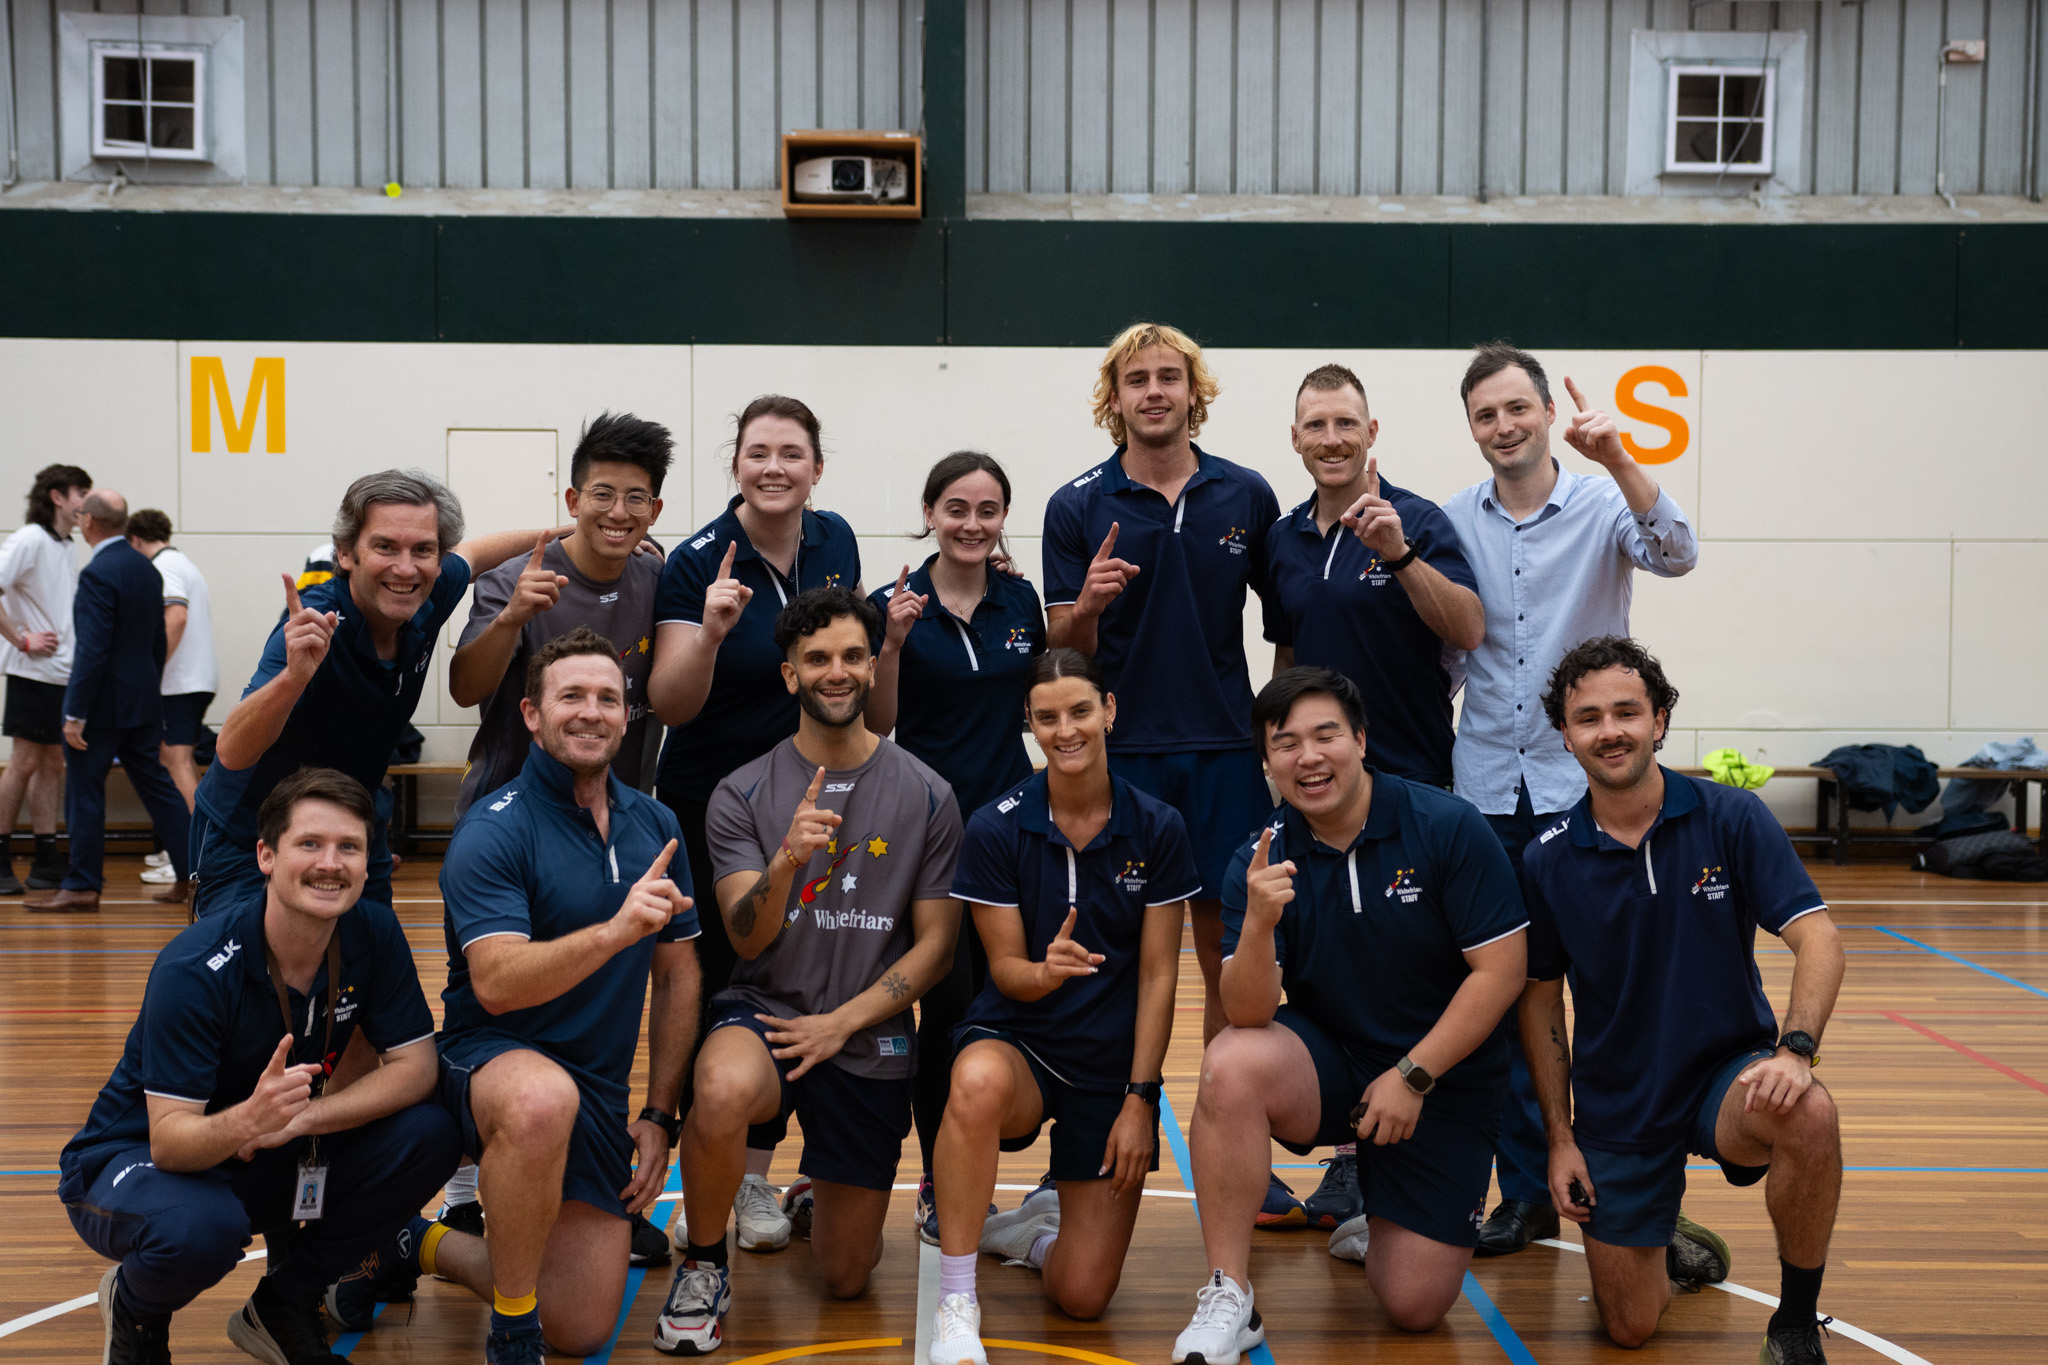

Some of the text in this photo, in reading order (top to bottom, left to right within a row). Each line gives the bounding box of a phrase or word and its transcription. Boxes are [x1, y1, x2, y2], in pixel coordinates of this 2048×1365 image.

[190, 356, 286, 453] M
[1615, 365, 1690, 465] S
[1073, 468, 1103, 489] BLK
[824, 783, 855, 793] SSA
[489, 790, 518, 812] BLK
[996, 790, 1024, 815] BL
[1702, 883, 1730, 893] Whitefriars
[1706, 891, 1724, 900] STAFF
[1401, 894, 1418, 904] STAFF
[814, 907, 895, 933] Whitefriars
[206, 938, 242, 972] BLK
[336, 1011, 352, 1022] STAFF
